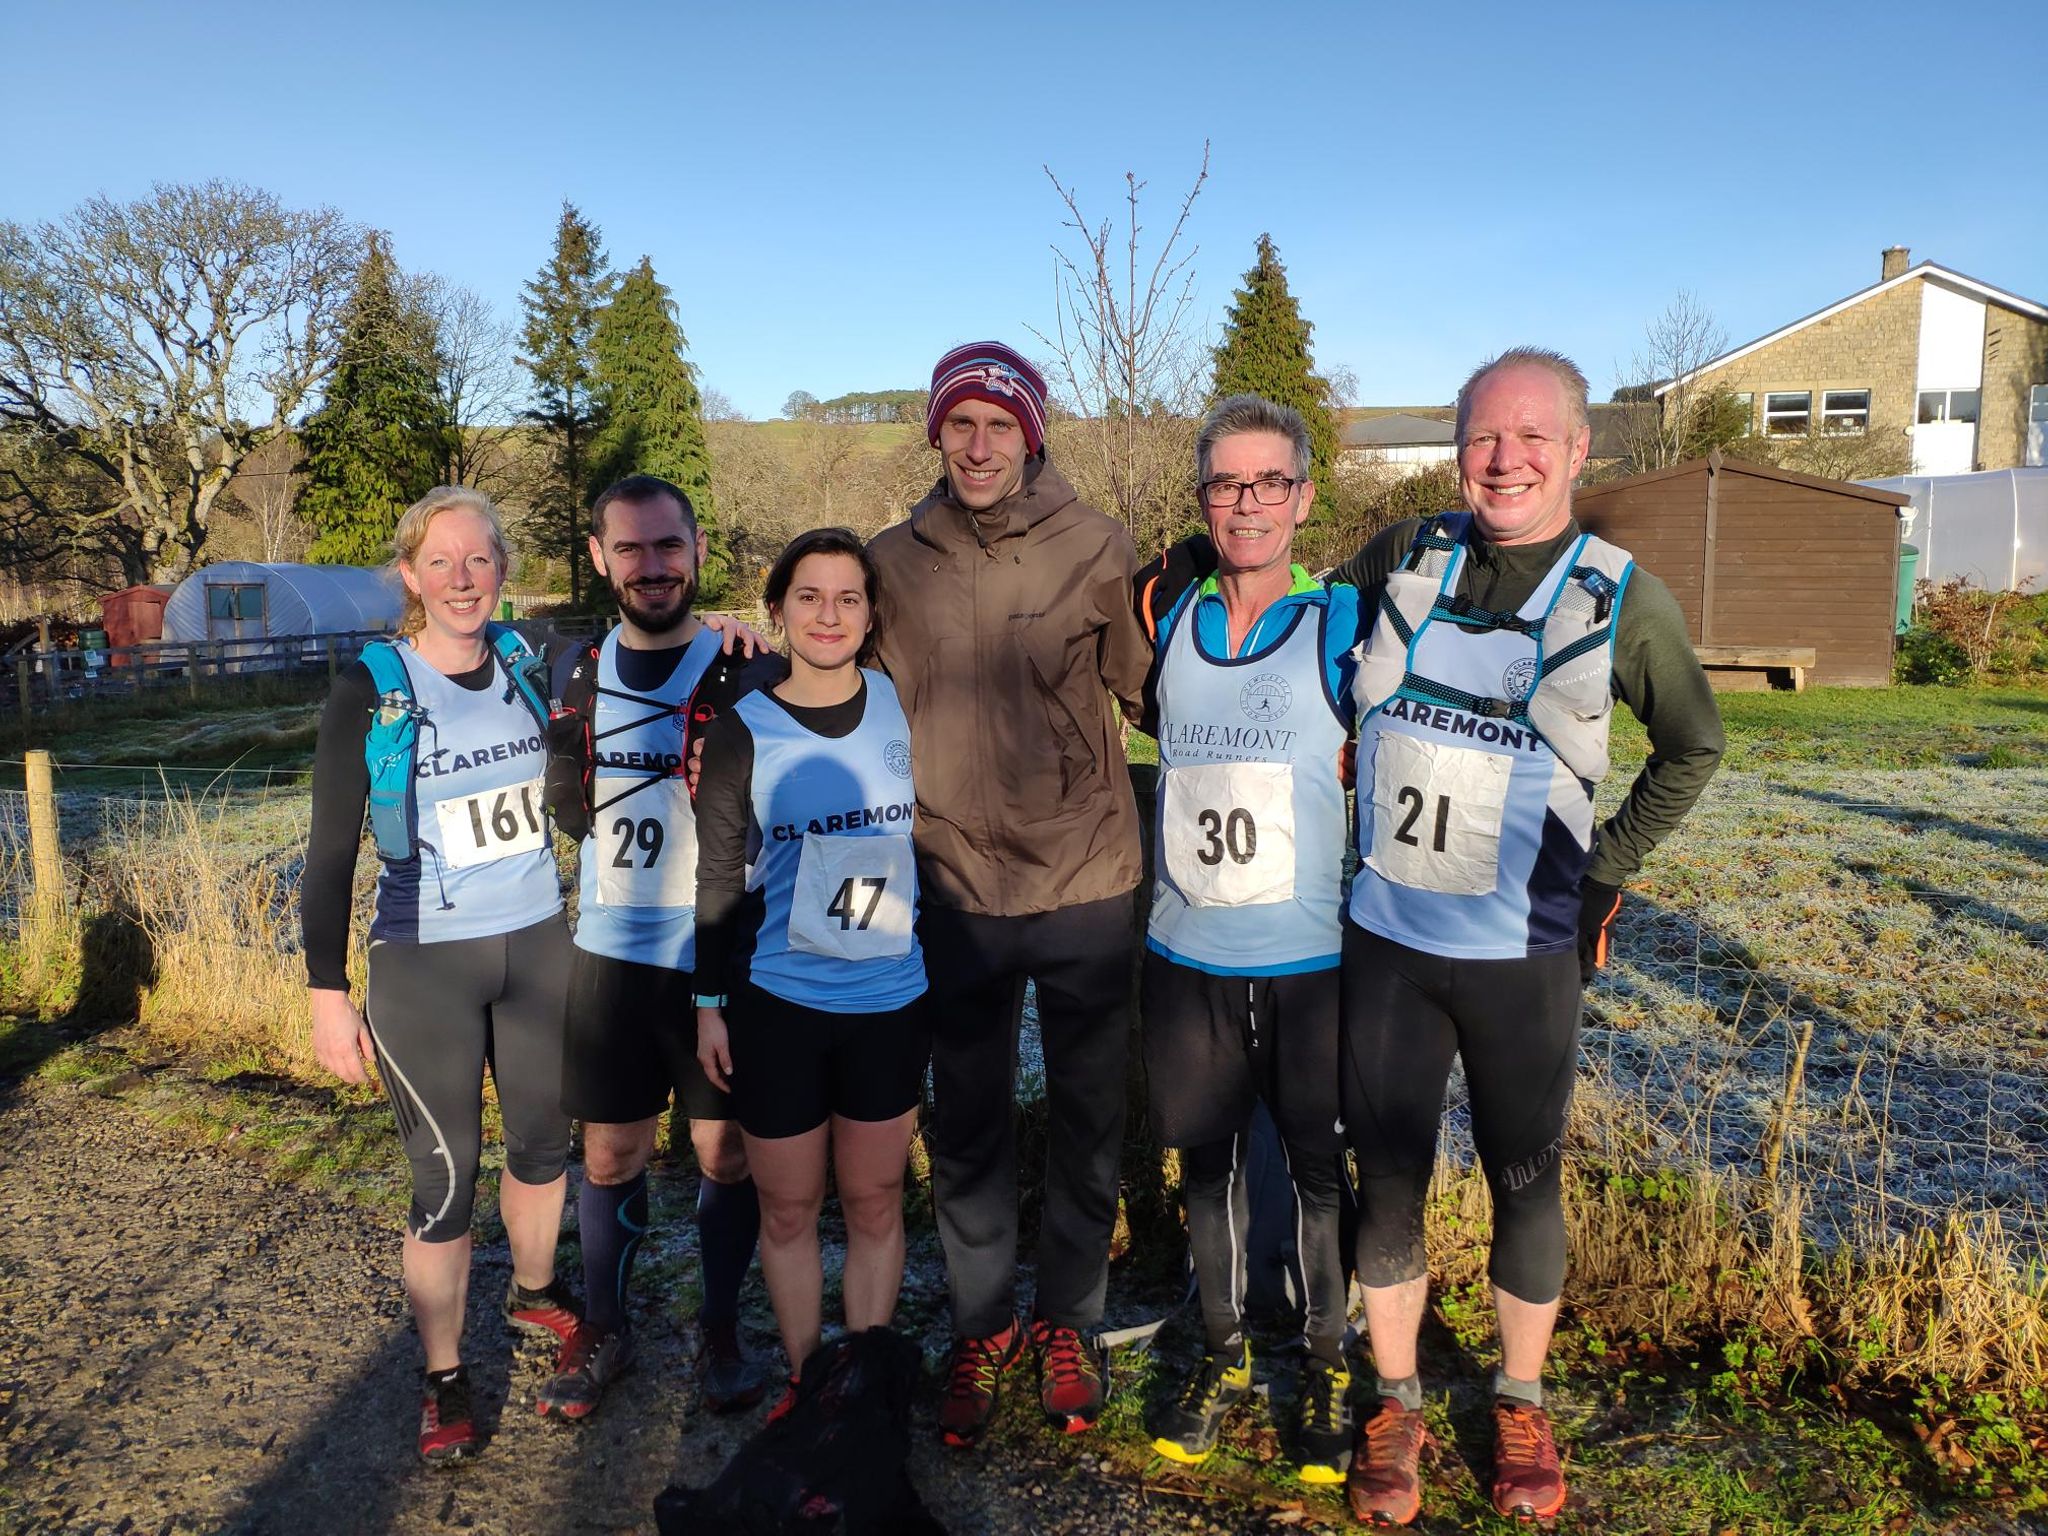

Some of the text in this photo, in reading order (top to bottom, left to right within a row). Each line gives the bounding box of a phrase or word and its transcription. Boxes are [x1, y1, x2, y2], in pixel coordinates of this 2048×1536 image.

[1161, 720, 1297, 751] CLAREMONT
[1172, 748, 1268, 763] Road Runners
[467, 786, 540, 848] 161
[611, 817, 665, 869] 29
[772, 801, 916, 842] CLAREMON
[1196, 807, 1257, 866] 30
[1394, 785, 1450, 852] 21
[827, 877, 888, 930] 47
